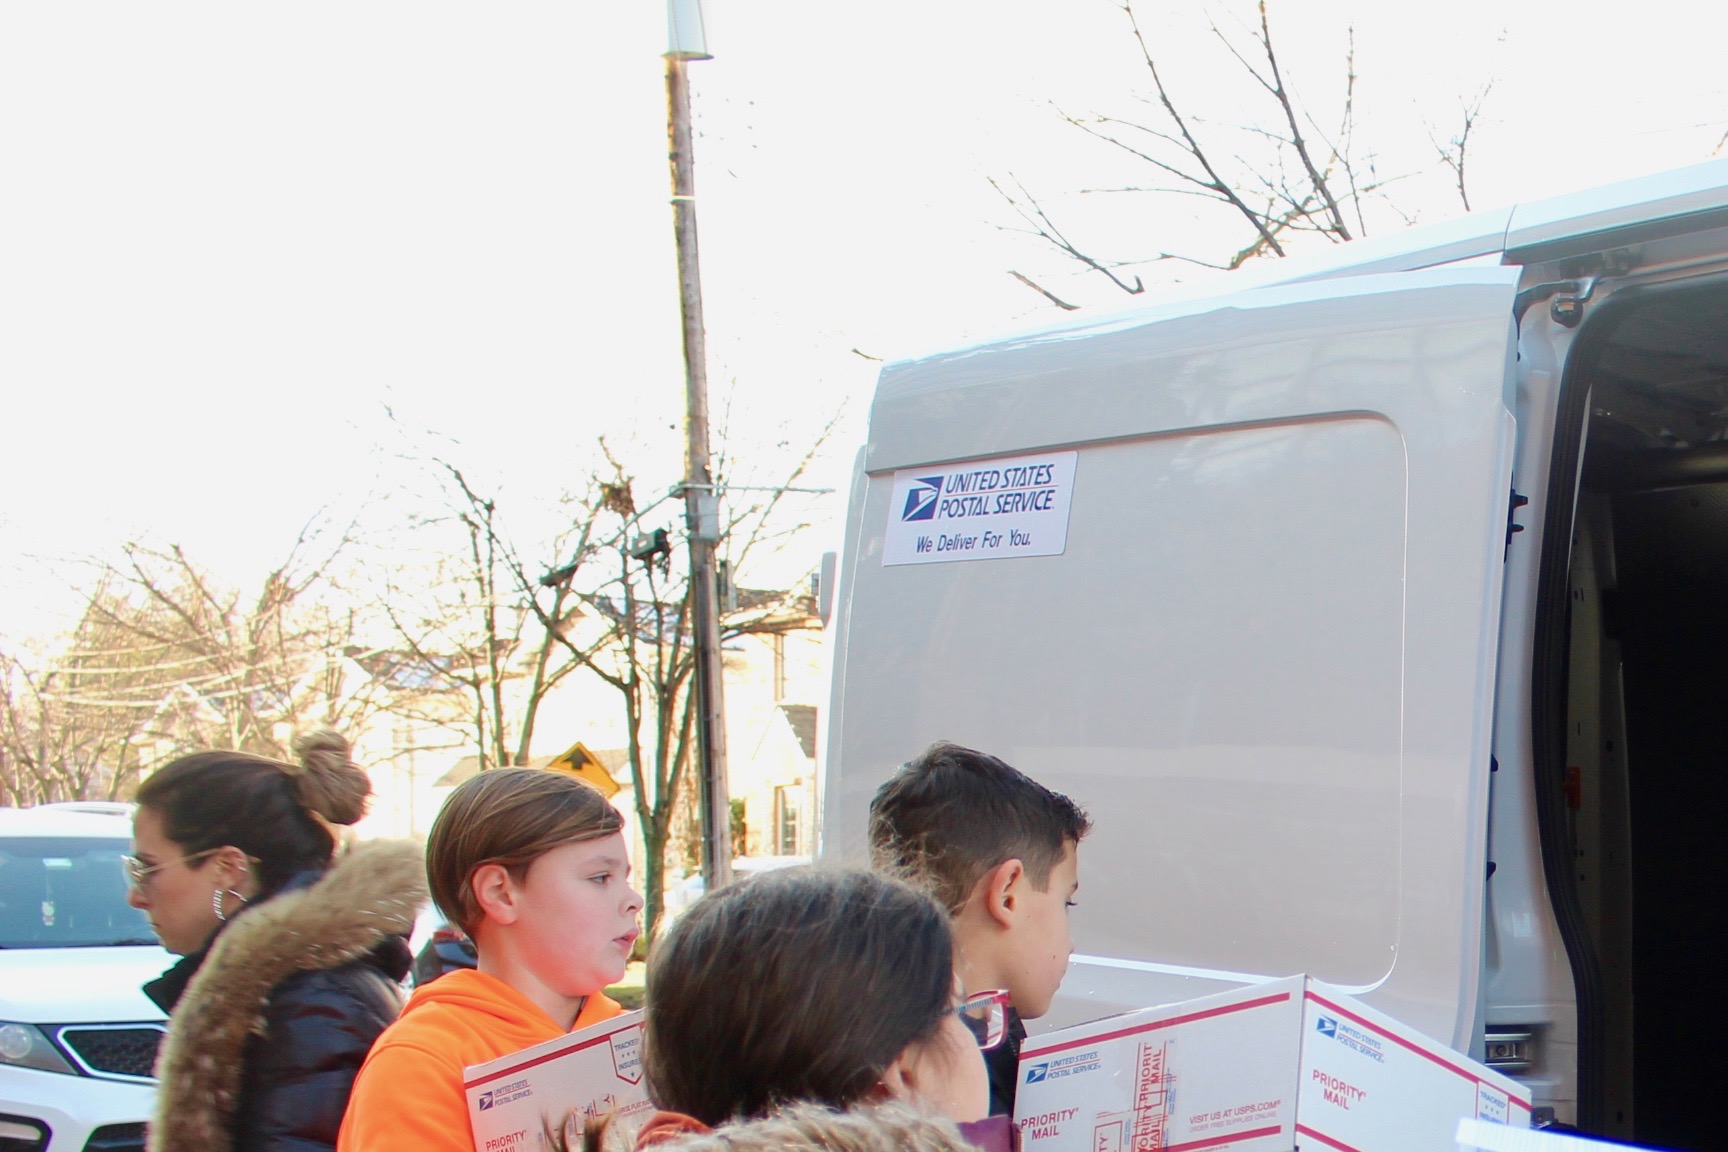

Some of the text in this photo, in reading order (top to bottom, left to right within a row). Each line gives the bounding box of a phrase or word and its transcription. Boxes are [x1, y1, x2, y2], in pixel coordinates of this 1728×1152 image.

[945, 464, 1055, 494] UNITED STATES
[938, 489, 1055, 520] POSTAL SERVICE
[916, 529, 1031, 553] We Deliver For You.
[1312, 1069, 1363, 1101] PRIORITY
[1323, 1089, 1349, 1110] MAIL
[1021, 1108, 1077, 1130] PRIORITY
[1189, 1113, 1209, 1124] VISIT
[1210, 1111, 1221, 1121] US
[1223, 1109, 1232, 1118] AT
[486, 1131, 525, 1152] PRIORITY
[1031, 1126, 1059, 1140] MAIL
